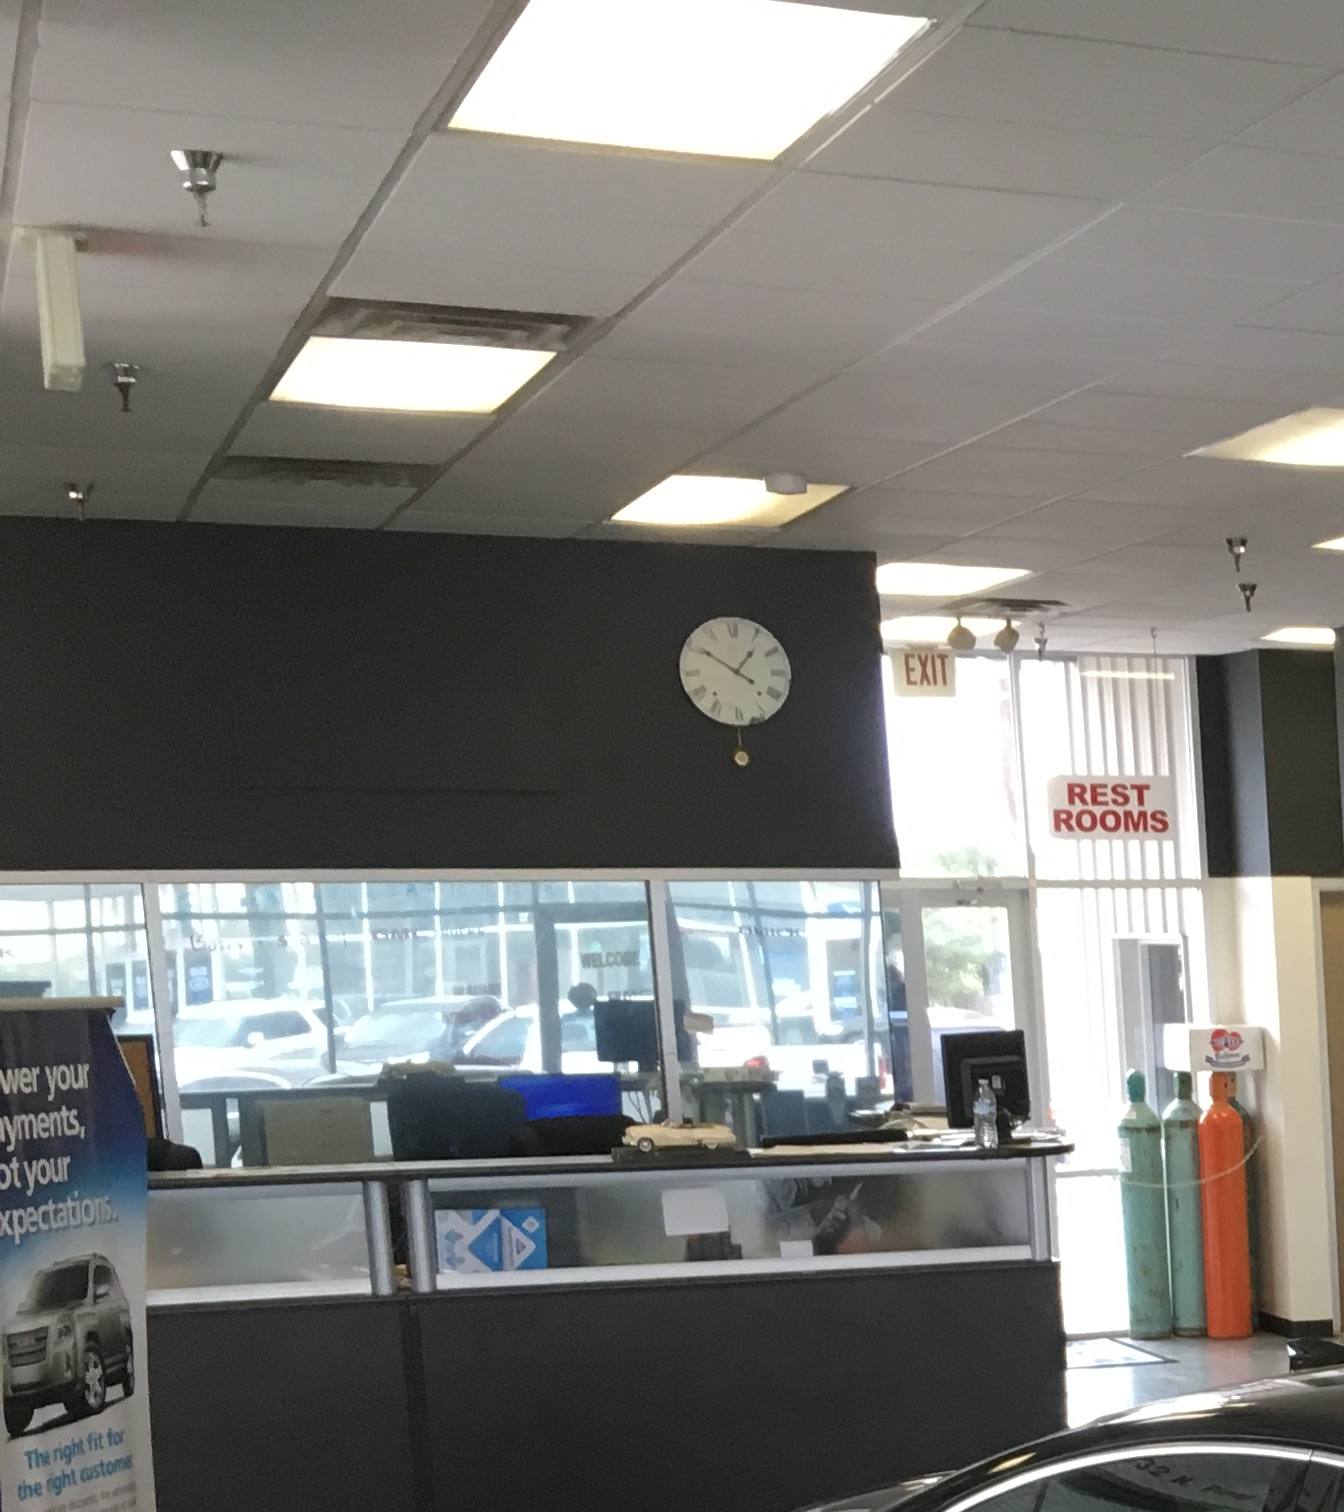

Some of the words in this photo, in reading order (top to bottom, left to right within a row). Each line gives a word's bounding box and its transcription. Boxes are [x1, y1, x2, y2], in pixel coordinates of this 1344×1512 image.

[904, 653, 949, 686] EXIT
[1066, 783, 1151, 807] REST
[1053, 809, 1169, 833] ROOMS
[45, 1063, 91, 1101] your
[23, 1155, 71, 1197] your
[24, 1447, 50, 1470] The
[53, 1438, 86, 1466] right
[87, 1431, 105, 1452] fit
[106, 1427, 126, 1447] for
[17, 1480, 43, 1501] the
[46, 1469, 78, 1496] right
